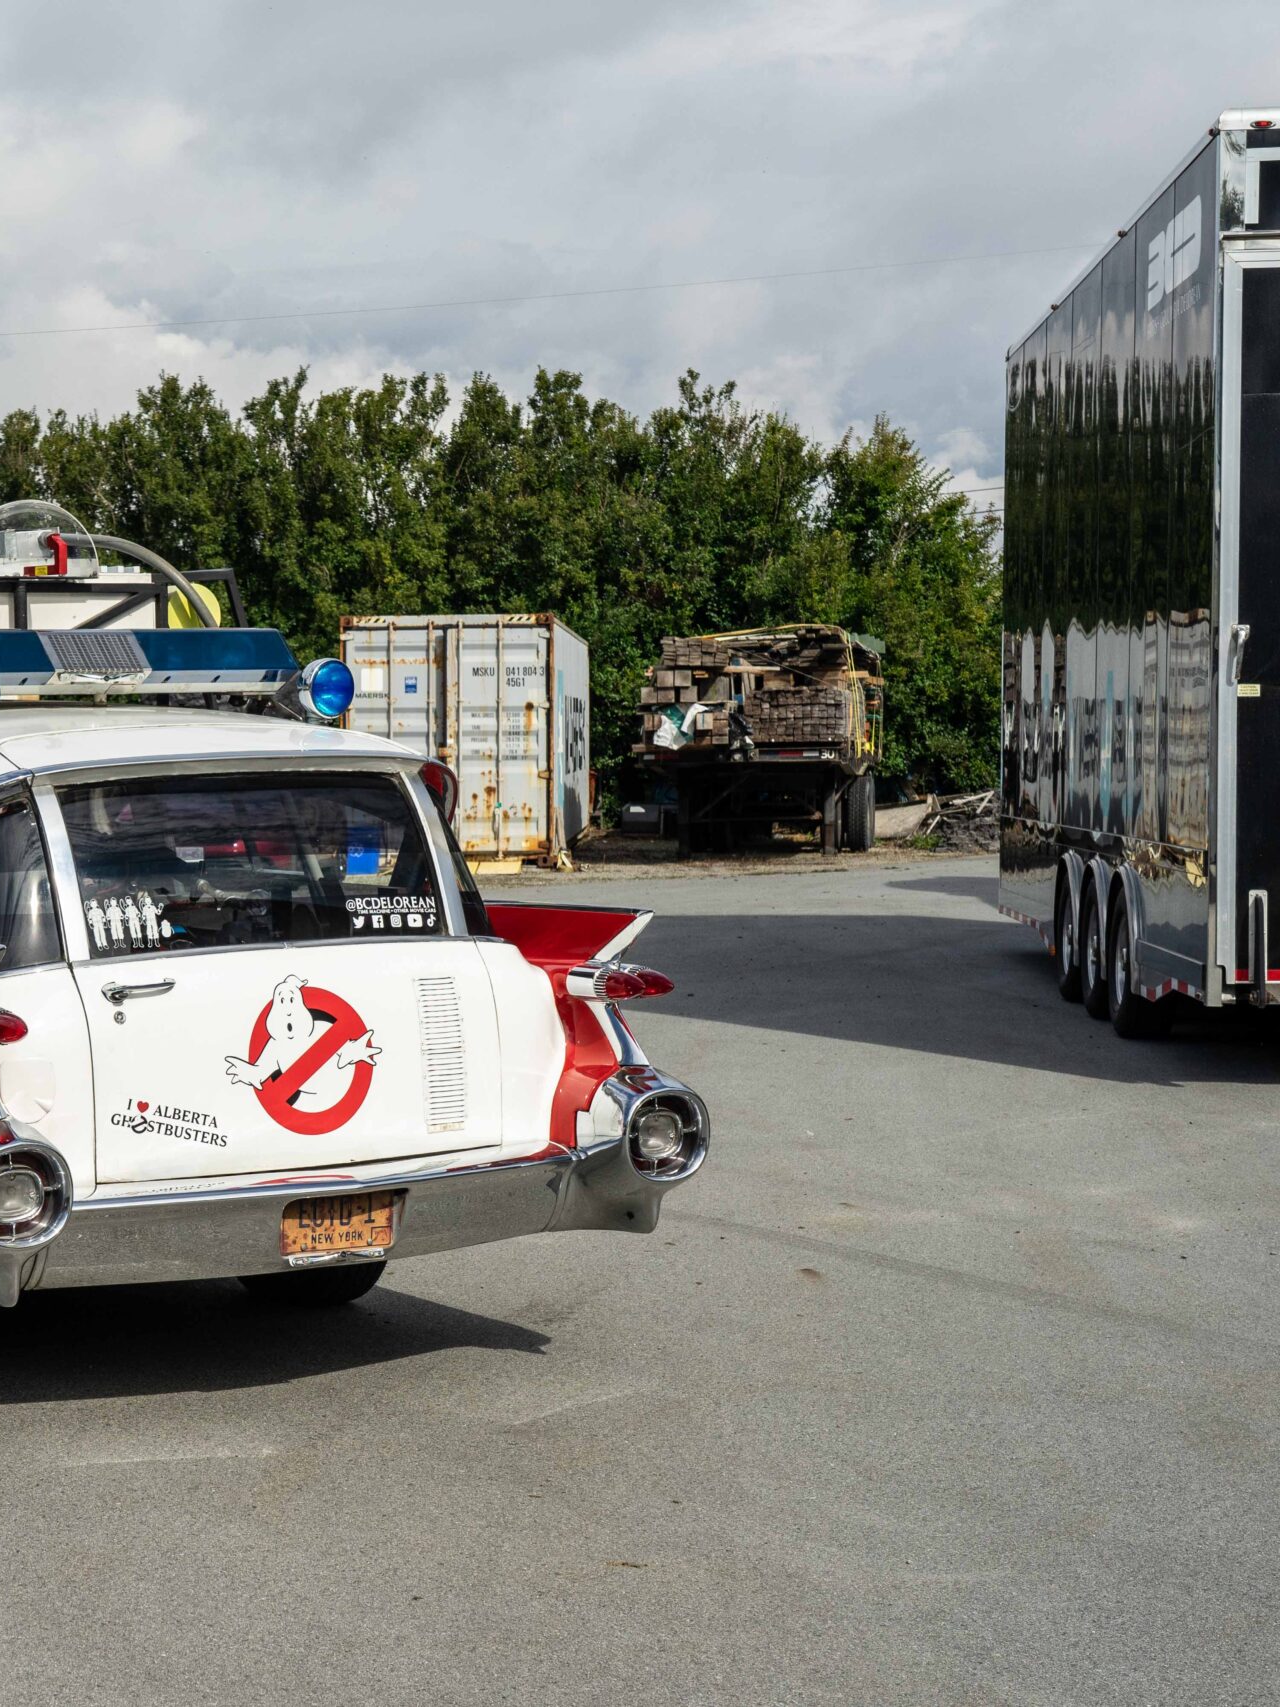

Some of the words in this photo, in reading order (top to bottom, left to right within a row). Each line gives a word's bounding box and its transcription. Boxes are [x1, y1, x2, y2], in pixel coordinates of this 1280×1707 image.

[472, 666, 495, 677] MSKU
[505, 666, 520, 677] 041
[522, 666, 537, 677] 804
[539, 666, 545, 677] 3
[505, 677, 525, 687] 45G1
[345, 896, 436, 912] @BCDELOREAN
[153, 1104, 218, 1129] ALBERTA
[311, 1233, 333, 1245] NEW
[338, 1231, 363, 1243] YORK
